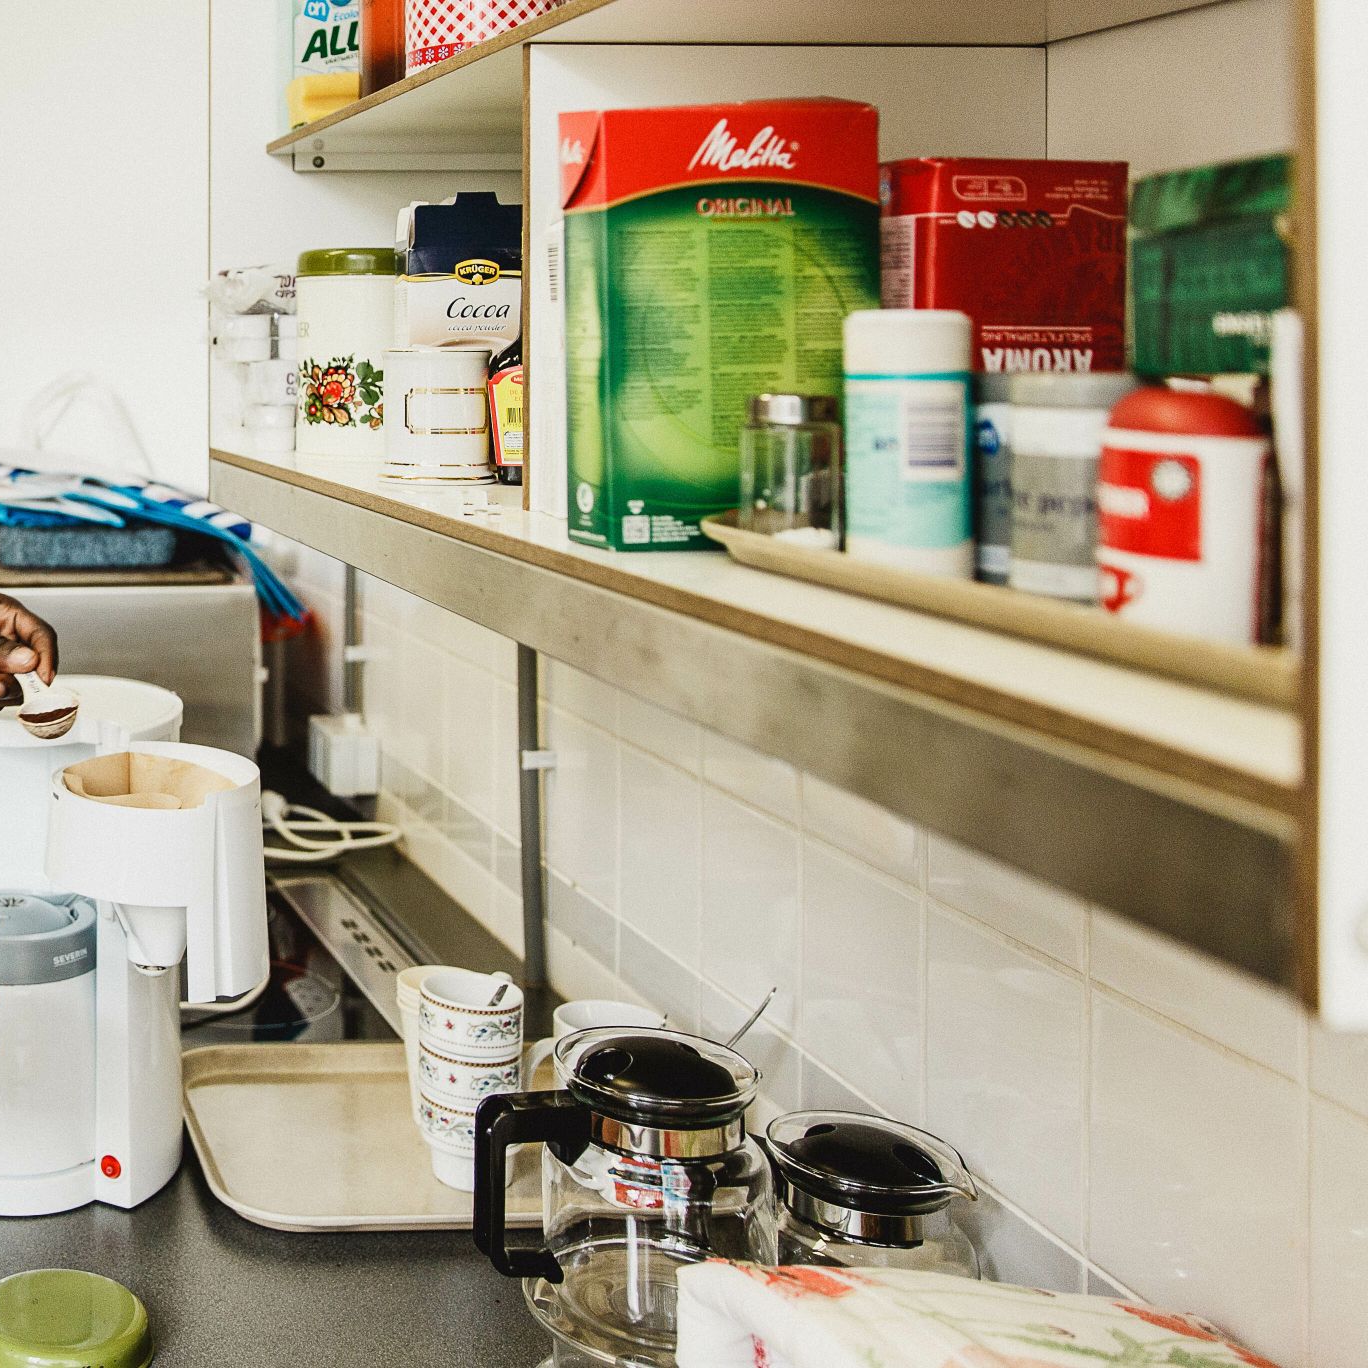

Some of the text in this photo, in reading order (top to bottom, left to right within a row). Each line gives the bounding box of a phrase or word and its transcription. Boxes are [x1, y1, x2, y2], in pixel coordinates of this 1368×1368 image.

[688, 118, 796, 171] Melitta
[697, 198, 796, 217] ORIGINAL
[459, 264, 496, 275] KRÜGER
[447, 297, 510, 319] Cocoa
[53, 947, 88, 965] SEVERIN
